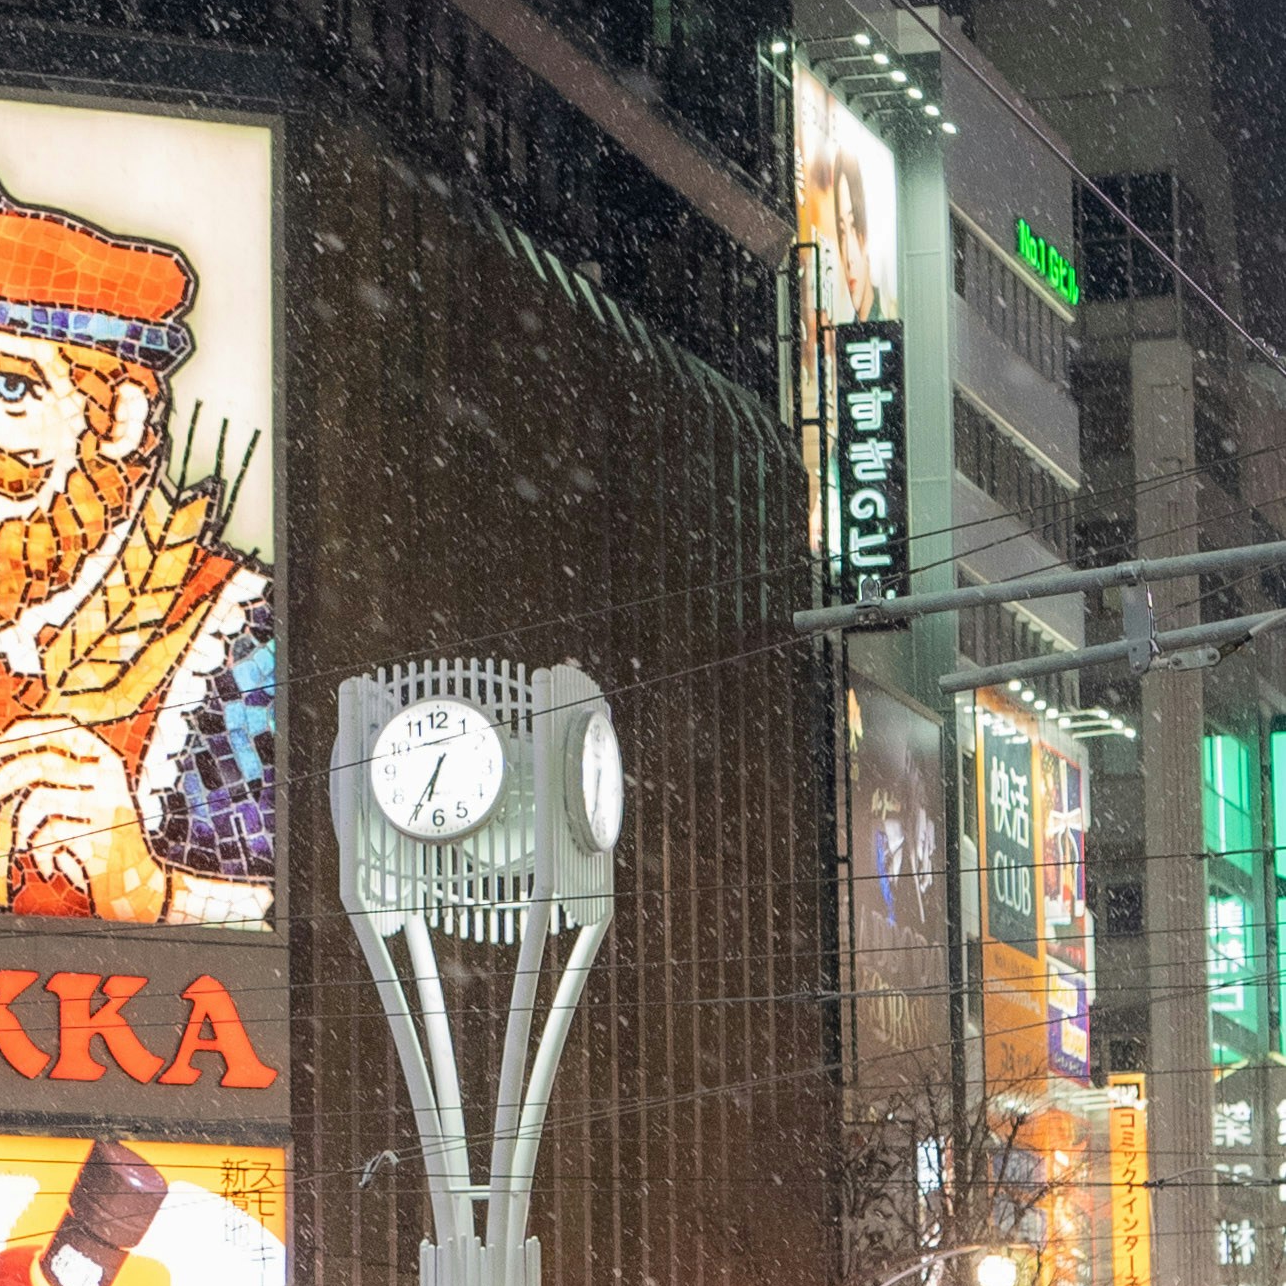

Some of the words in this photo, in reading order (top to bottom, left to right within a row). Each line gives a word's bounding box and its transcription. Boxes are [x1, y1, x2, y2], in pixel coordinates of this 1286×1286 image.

[407, 719, 423, 738] 11
[425, 710, 449, 730] 12
[458, 717, 467, 735] 1
[455, 800, 469, 819] 5
[989, 754, 1030, 850] 快活
[431, 807, 446, 828] 6
[992, 848, 1032, 918] CLUB
